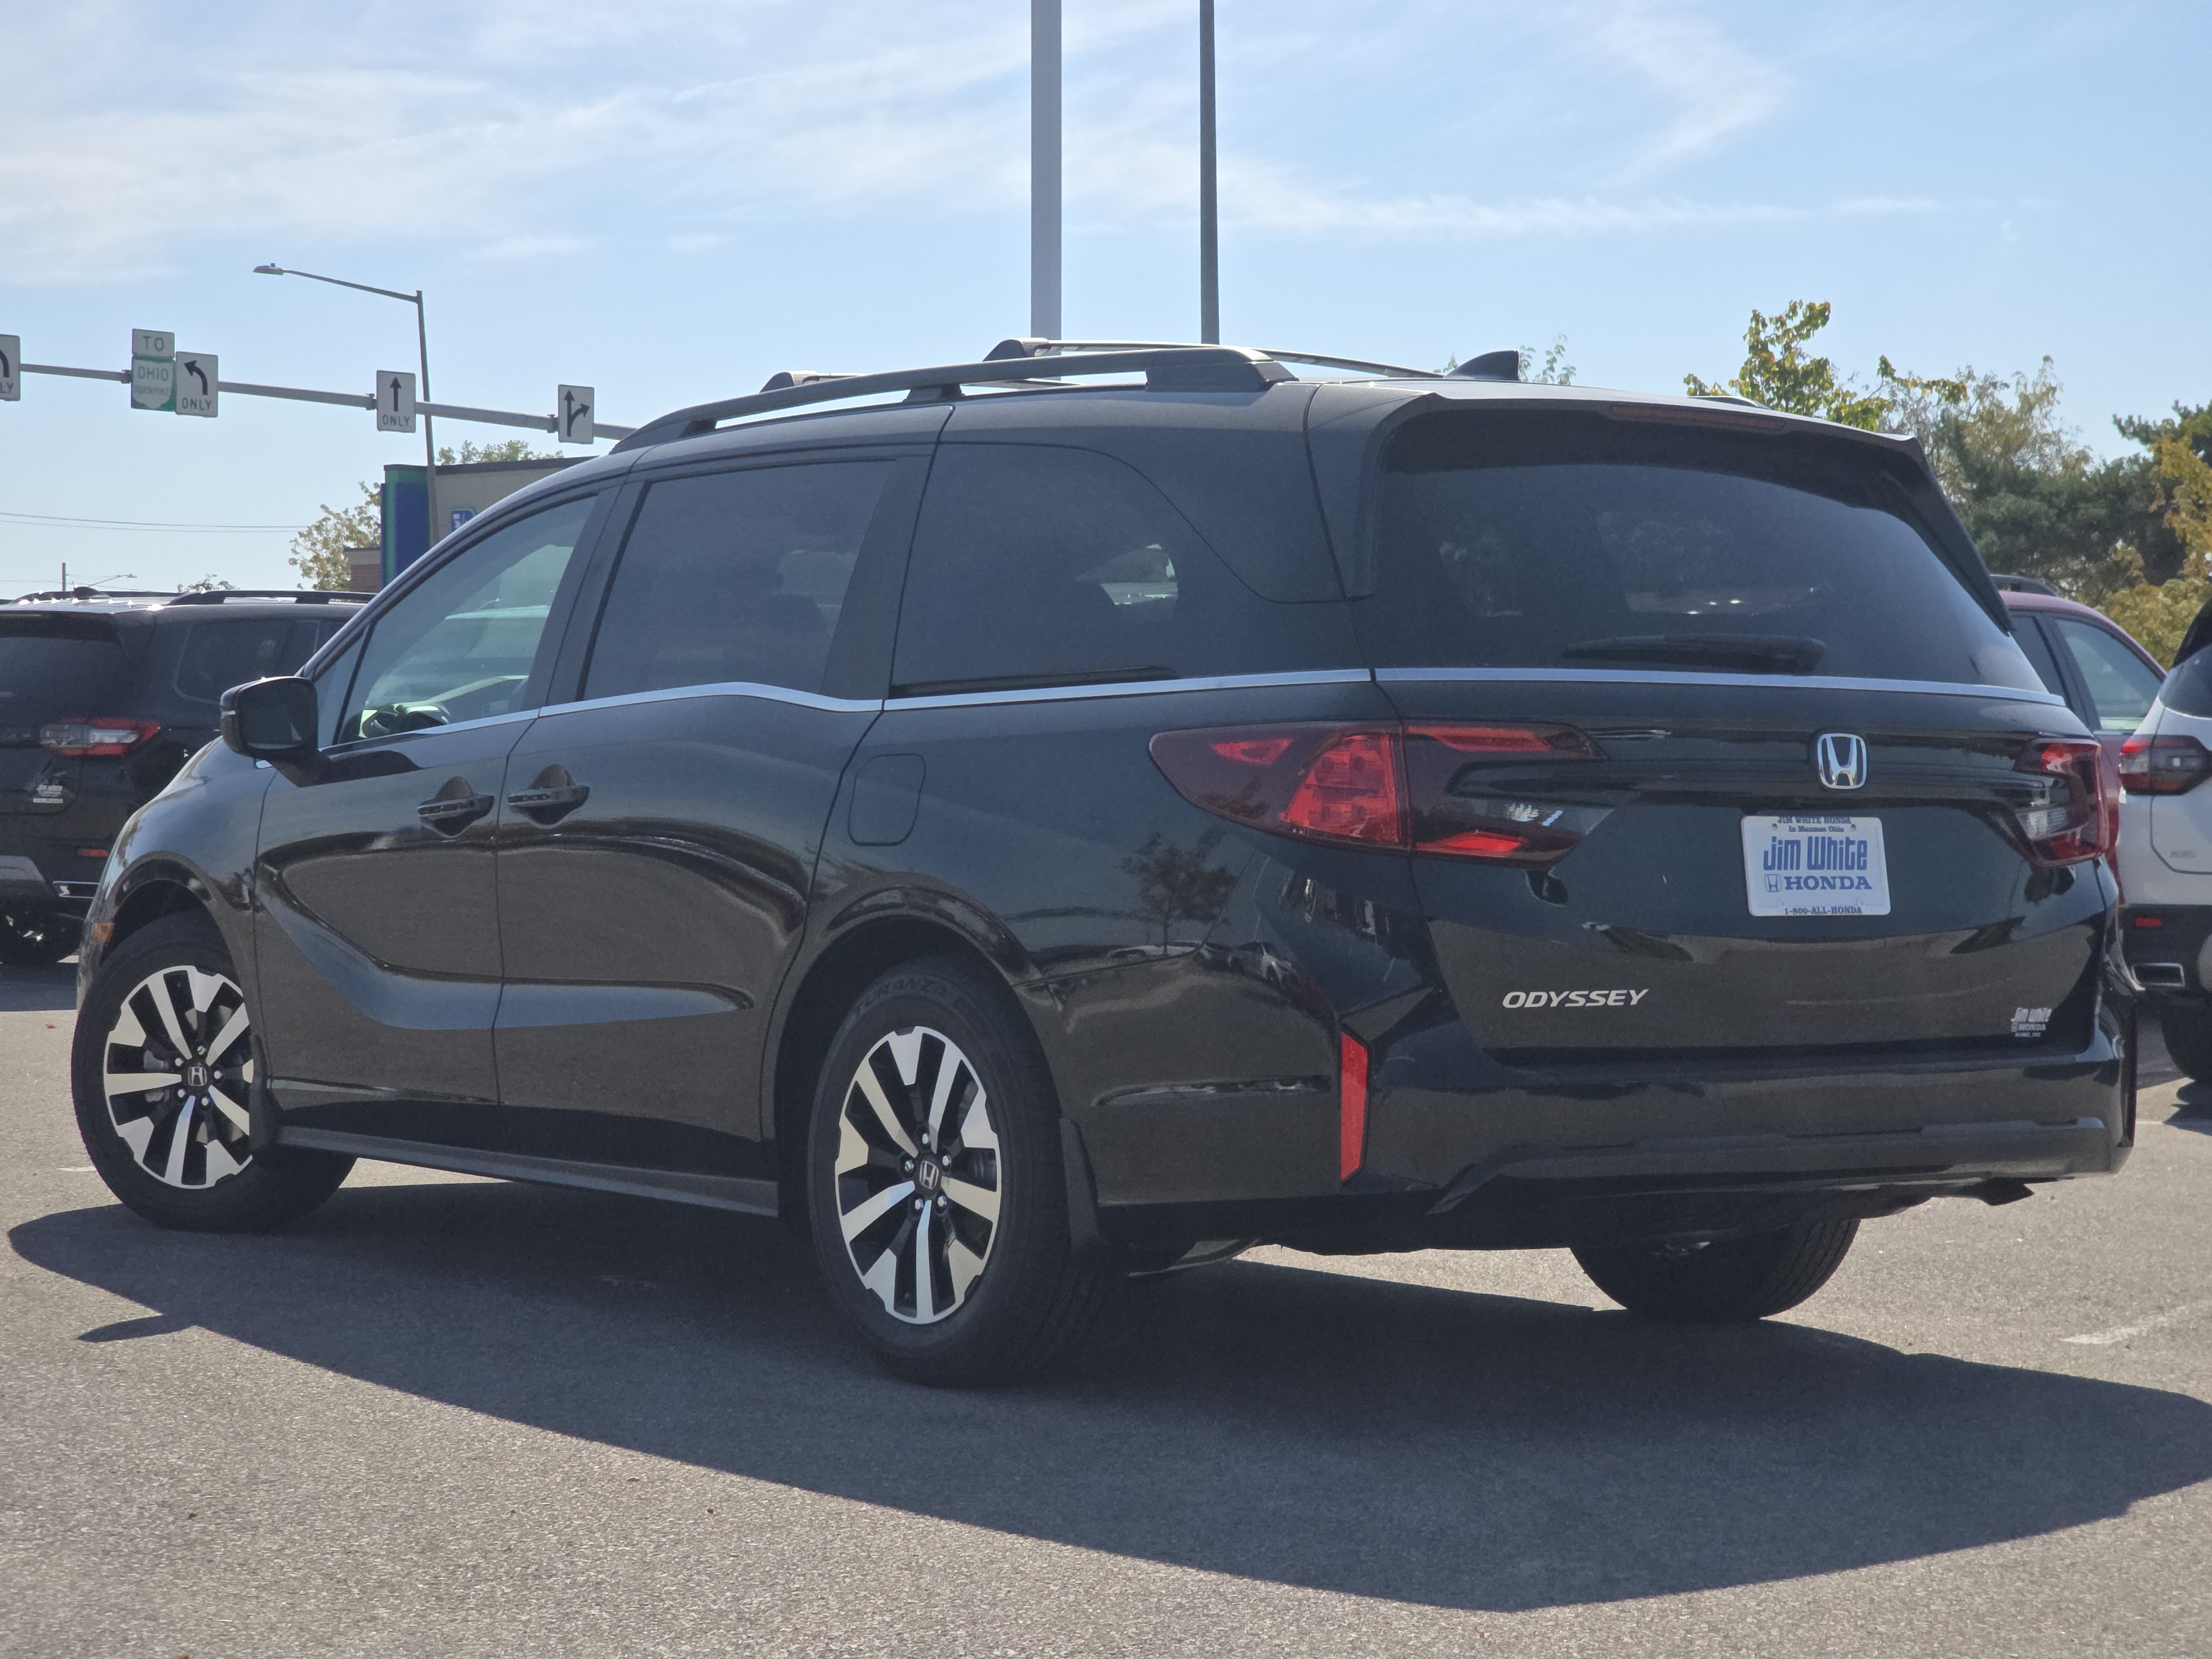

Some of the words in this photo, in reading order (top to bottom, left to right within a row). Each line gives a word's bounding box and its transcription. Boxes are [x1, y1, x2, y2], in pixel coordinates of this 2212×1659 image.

[143, 335, 164, 352] TO
[137, 366, 169, 382] OHIO
[181, 398, 212, 411] ONLY
[382, 414, 410, 427] ONLY
[1824, 816, 1852, 825] HONDA
[1784, 875, 1872, 890] HONDA
[1785, 906, 1863, 915] 1-800-ALL-HONDA
[1502, 989, 1649, 1009] ODYSSEY
